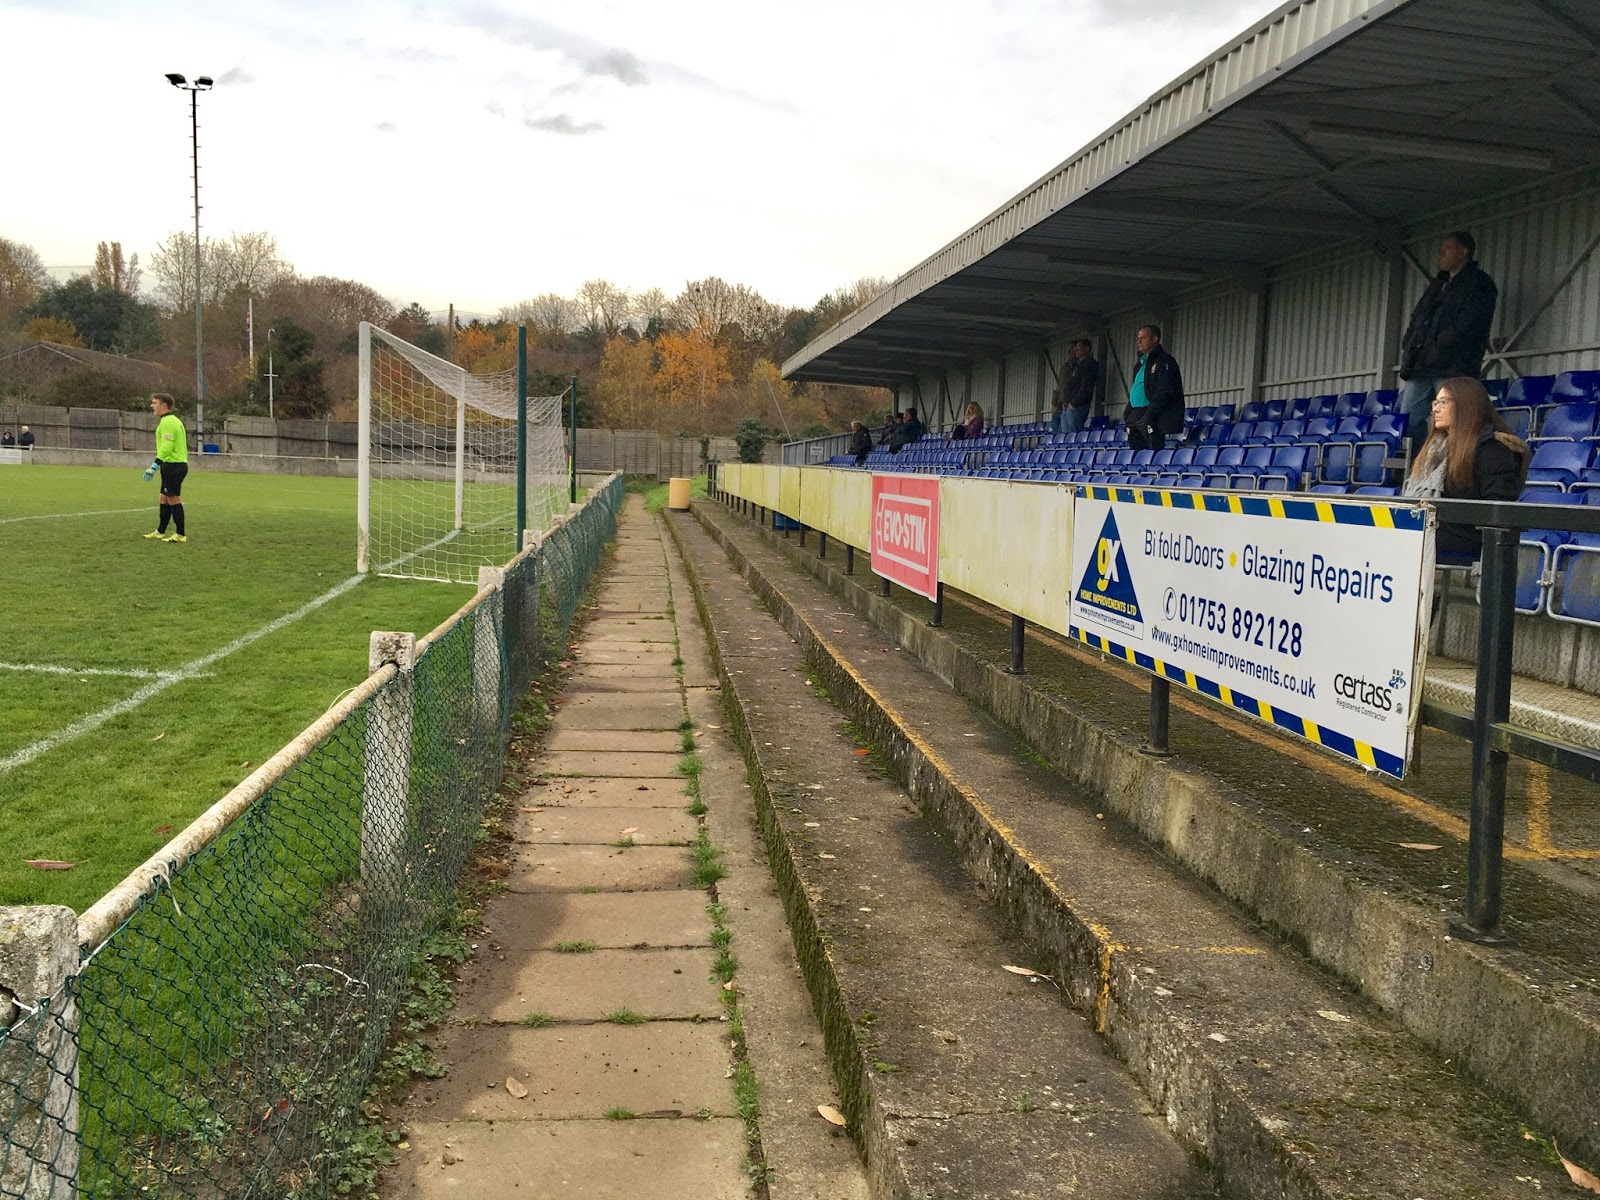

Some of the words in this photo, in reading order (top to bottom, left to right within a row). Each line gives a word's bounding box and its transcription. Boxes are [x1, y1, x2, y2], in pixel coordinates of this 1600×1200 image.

[883, 509, 926, 555] EVO-STIK
[1184, 535, 1224, 570] Doors
[1242, 544, 1305, 595] Glazing
[1310, 553, 1394, 603] Repairs
[1080, 588, 1092, 602] HOME
[1092, 593, 1126, 613] IMPROVEMENTS
[1126, 603, 1137, 617] LTD
[1179, 593, 1226, 634] 01753
[1232, 607, 1303, 658] 892128
[1151, 625, 1316, 699] www.gxhomeimprovements.co.uk
[1334, 673, 1392, 712] certass
[1336, 697, 1361, 713] Registered
[1361, 706, 1387, 722] Contractor
